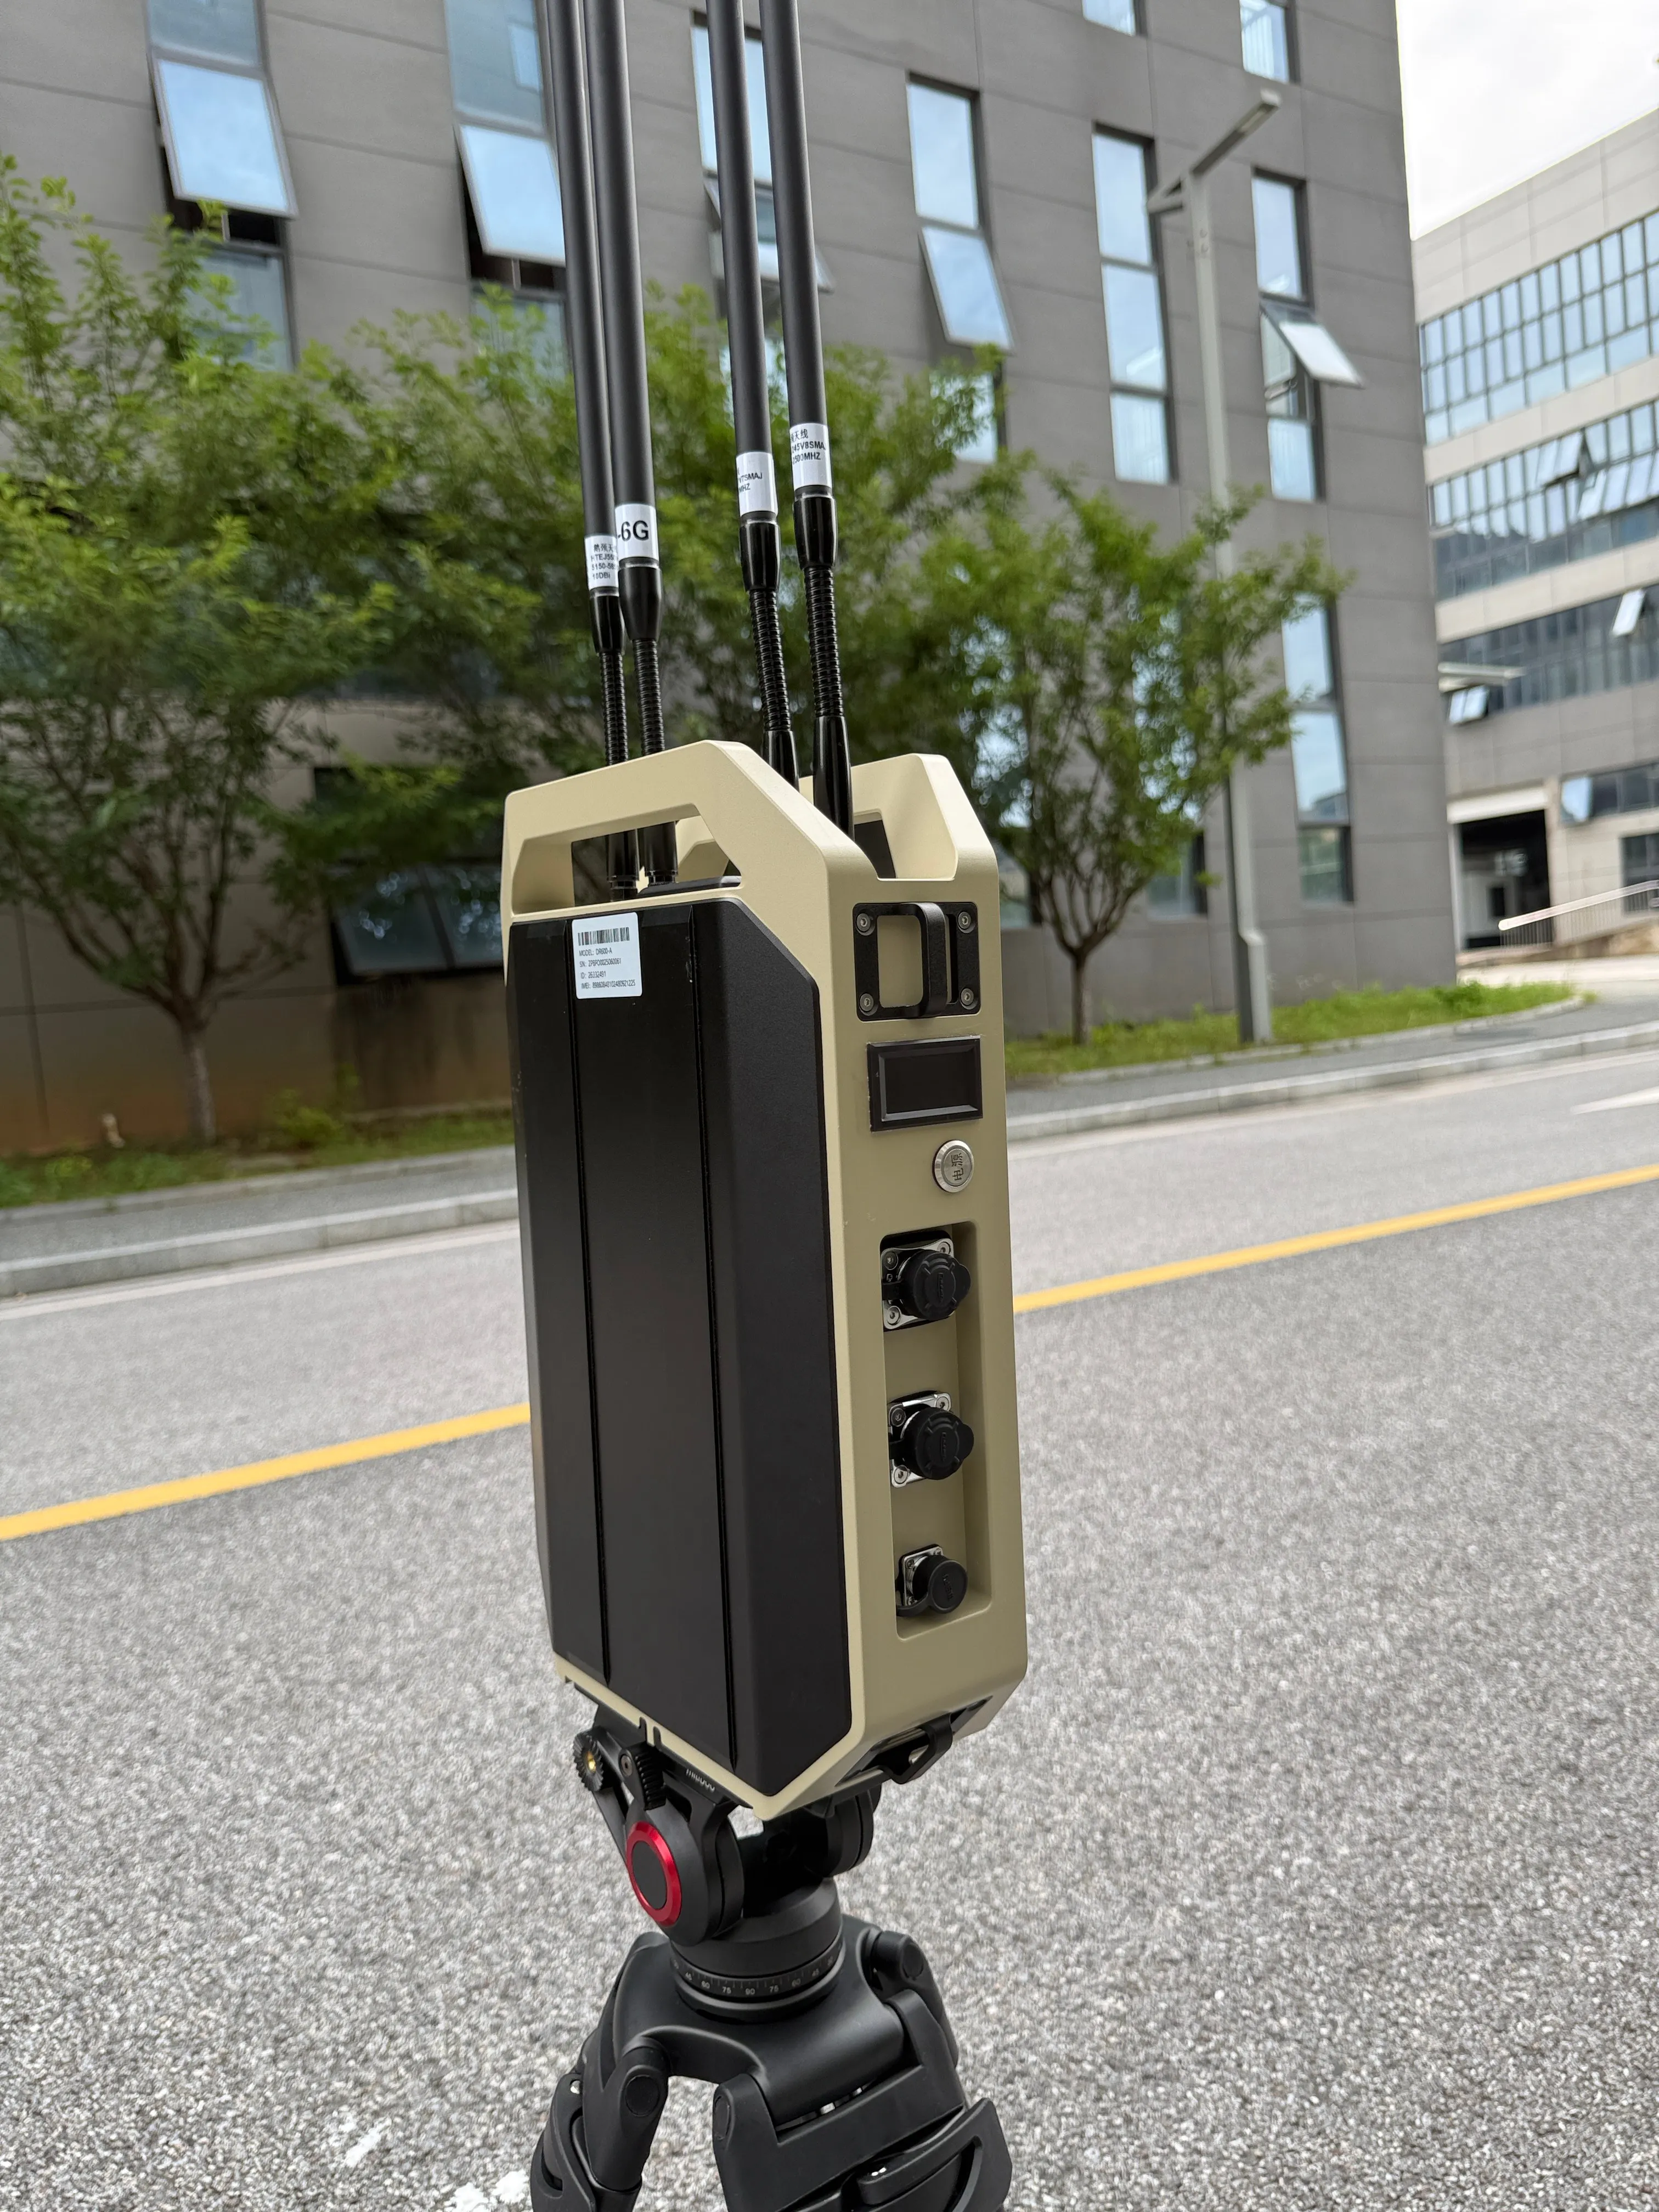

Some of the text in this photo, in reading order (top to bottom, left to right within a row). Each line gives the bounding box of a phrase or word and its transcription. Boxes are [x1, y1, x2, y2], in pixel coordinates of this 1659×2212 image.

[951, 1153, 964, 1181] 电源
[722, 1986, 732, 1995] 75
[769, 1985, 779, 1993] 75
